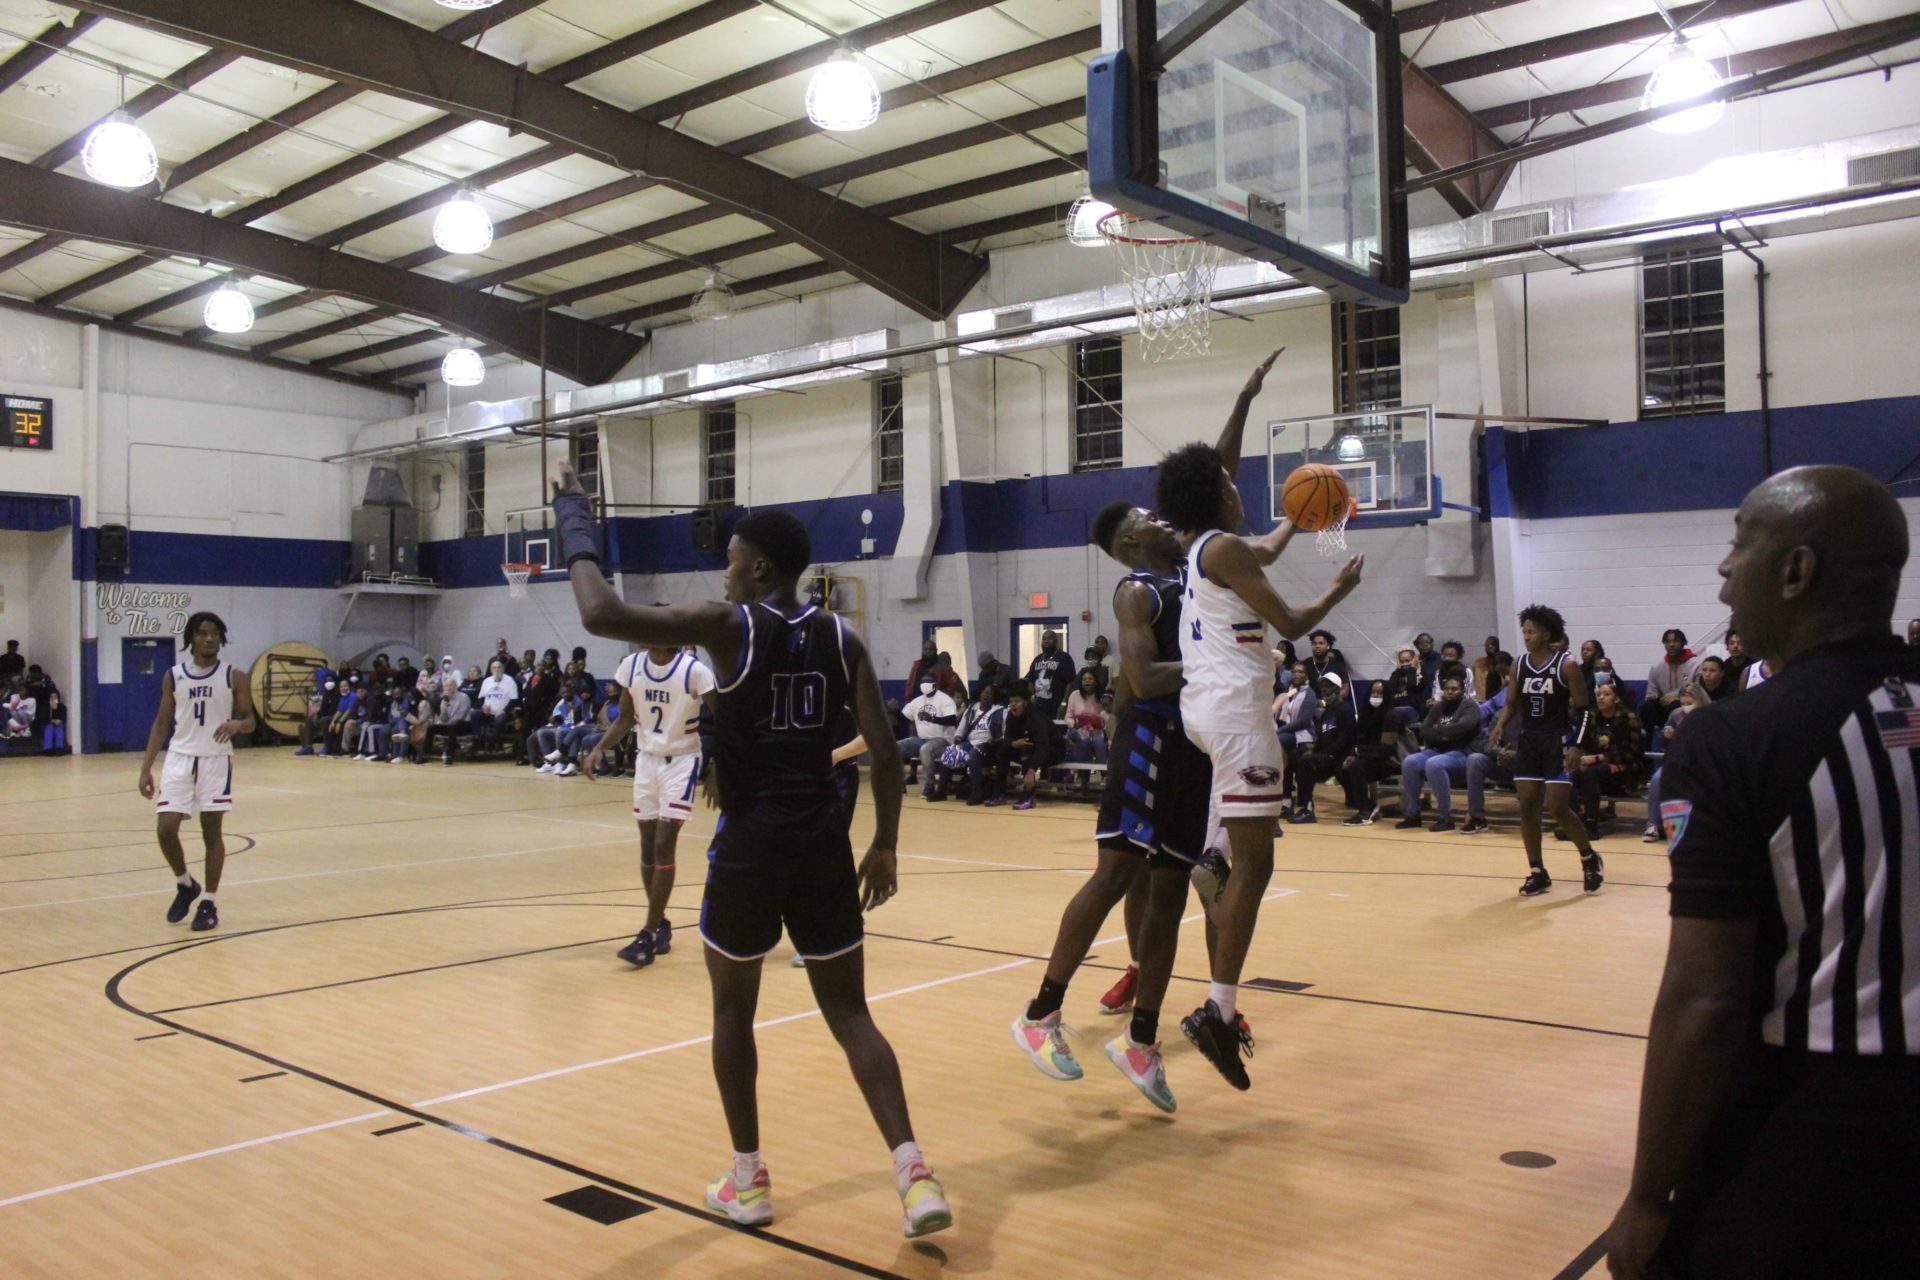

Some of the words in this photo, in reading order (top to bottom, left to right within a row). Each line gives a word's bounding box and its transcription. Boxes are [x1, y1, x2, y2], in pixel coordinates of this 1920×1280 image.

[8, 399, 44, 410] HOME
[15, 412, 42, 435] 32
[96, 583, 191, 610] Welcome
[106, 611, 122, 625] to
[125, 609, 161, 636] The
[168, 610, 190, 635] D
[189, 686, 213, 700] NFEI
[645, 688, 670, 704] NFEI
[1522, 677, 1554, 695] ICA
[771, 671, 827, 730] 10
[1530, 696, 1545, 717] 3
[194, 701, 205, 727] 4
[650, 705, 663, 734] 2
